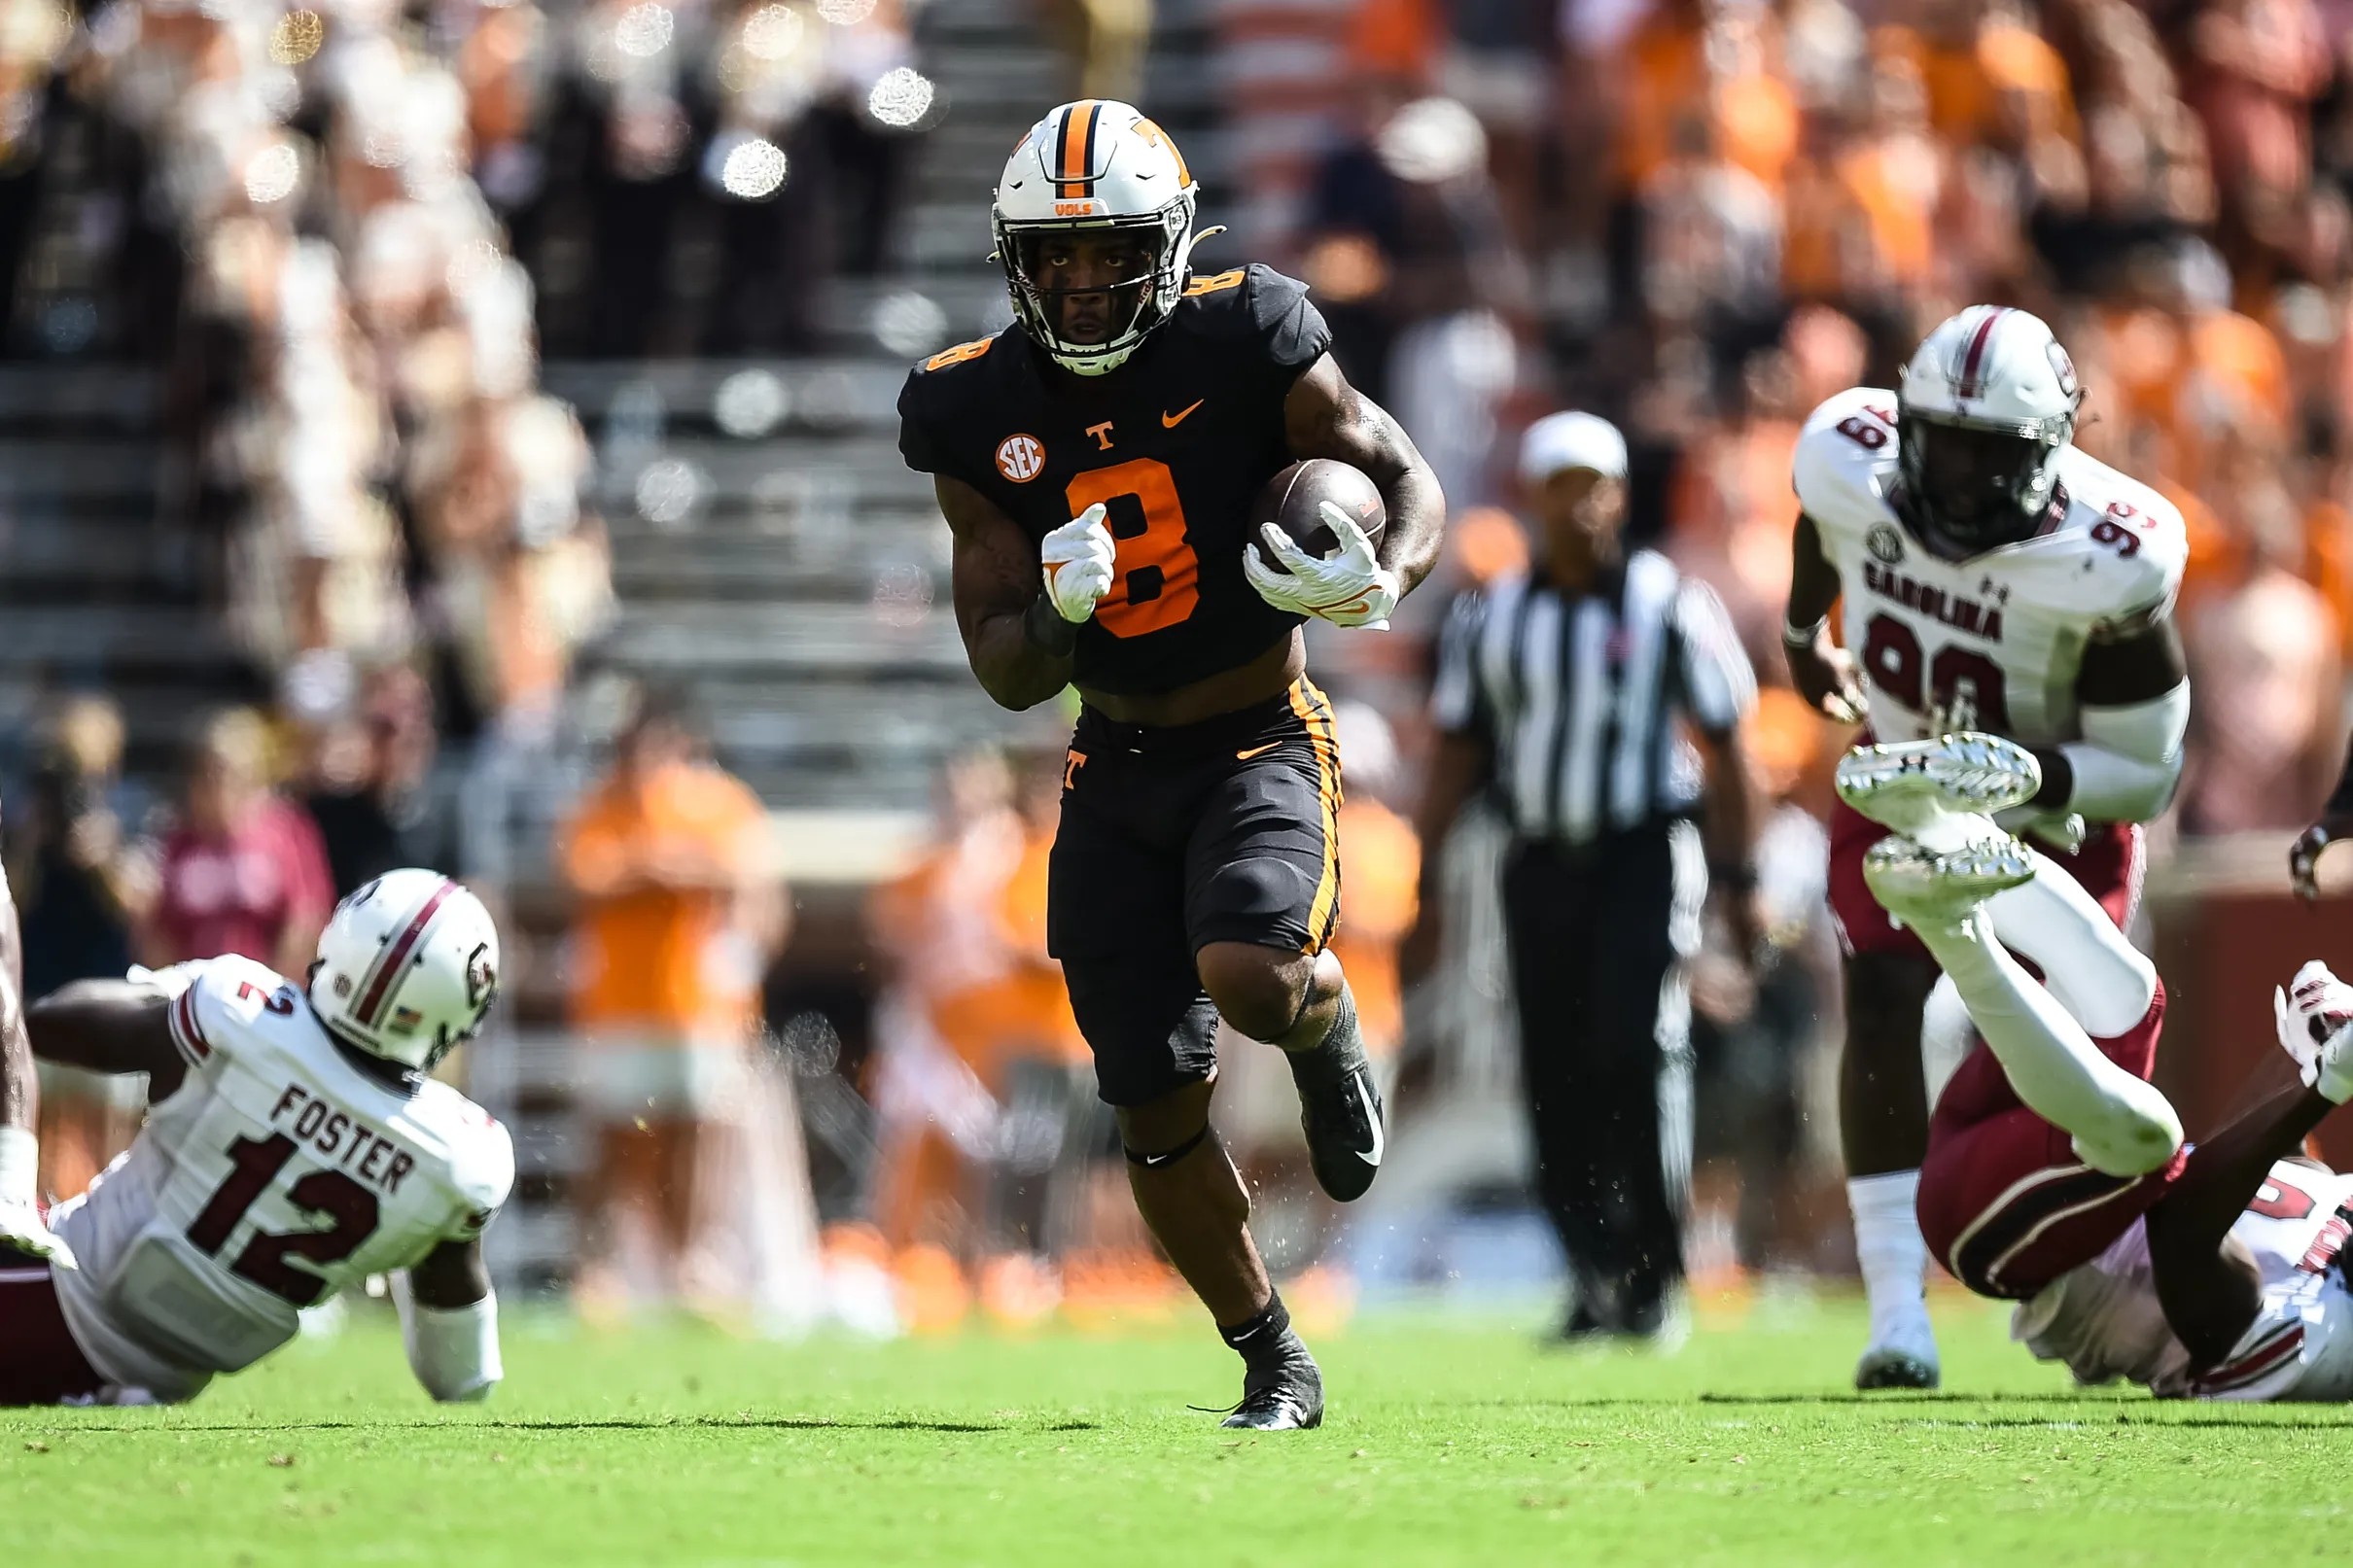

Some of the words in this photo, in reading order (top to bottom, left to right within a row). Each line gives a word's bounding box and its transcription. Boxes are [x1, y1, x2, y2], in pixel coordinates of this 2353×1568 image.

[1055, 201, 1093, 216] VOLS
[926, 336, 995, 371] 8
[1086, 421, 1115, 451] T
[999, 436, 1043, 479] SEC
[1065, 458, 1201, 639] 8
[1065, 749, 1088, 790] T
[269, 1082, 416, 1195] FOSTER
[187, 1132, 380, 1307] 12
